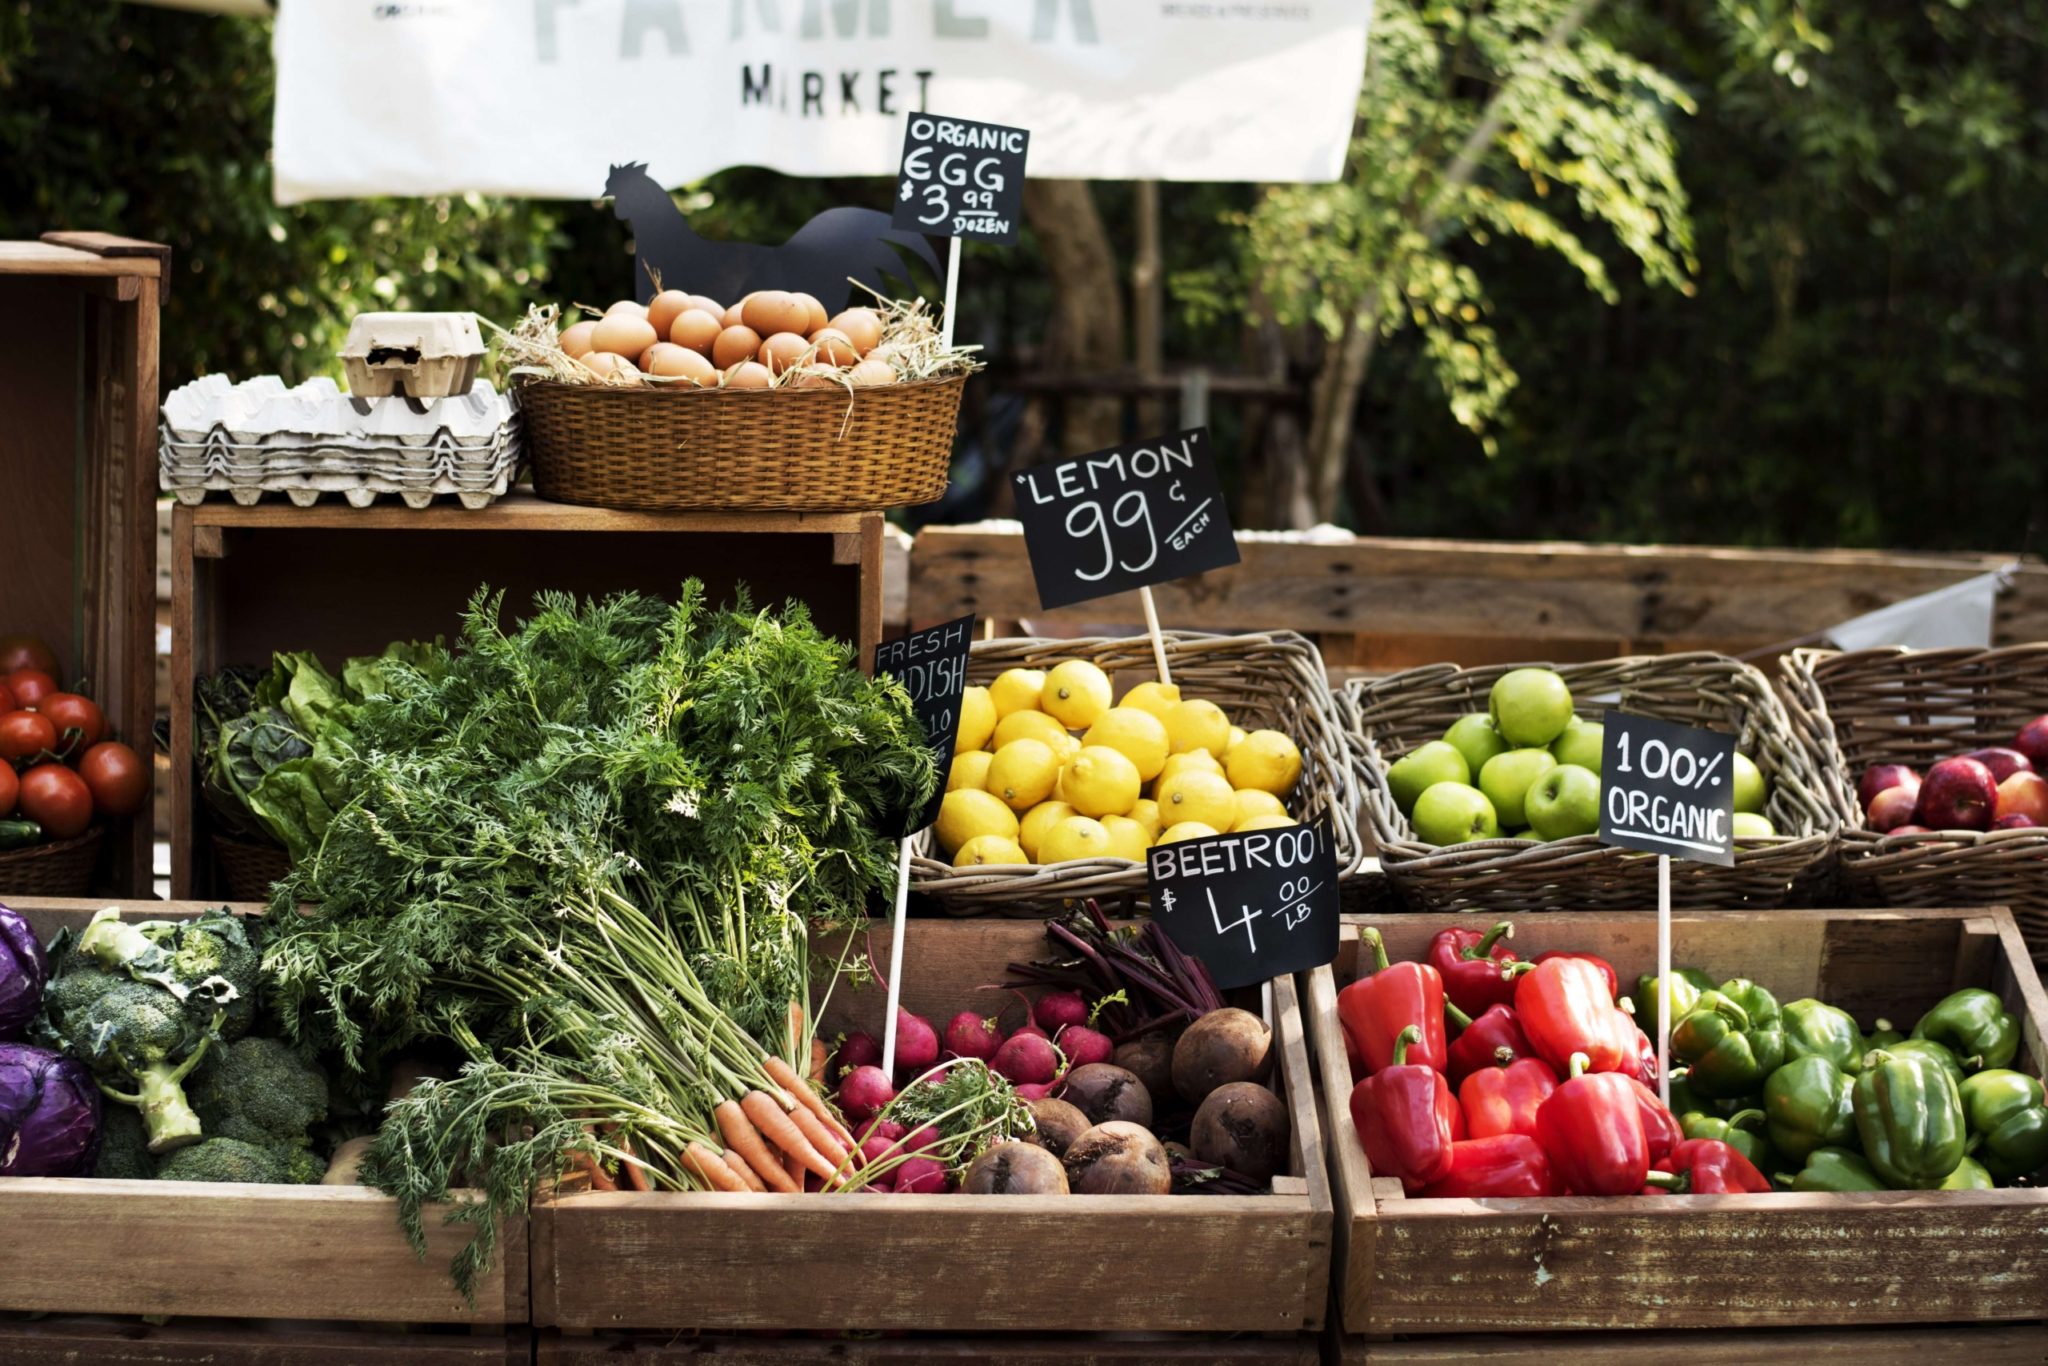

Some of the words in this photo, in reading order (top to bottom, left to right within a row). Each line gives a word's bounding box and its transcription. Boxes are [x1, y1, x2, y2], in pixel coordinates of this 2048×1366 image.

[910, 118, 1023, 154] ORGANIC
[903, 145, 1005, 193] EGG
[962, 189, 994, 210] 99
[952, 216, 1010, 235] DOZEN
[1171, 512, 1211, 552] EACH
[876, 623, 964, 668] FRESH
[897, 653, 967, 703] DISH
[1616, 730, 1725, 790] 100%
[1607, 785, 1728, 844] ORGANIC
[1151, 818, 1325, 881] BEETROOT
[1279, 876, 1310, 902] 00
[1284, 902, 1312, 932] LB
